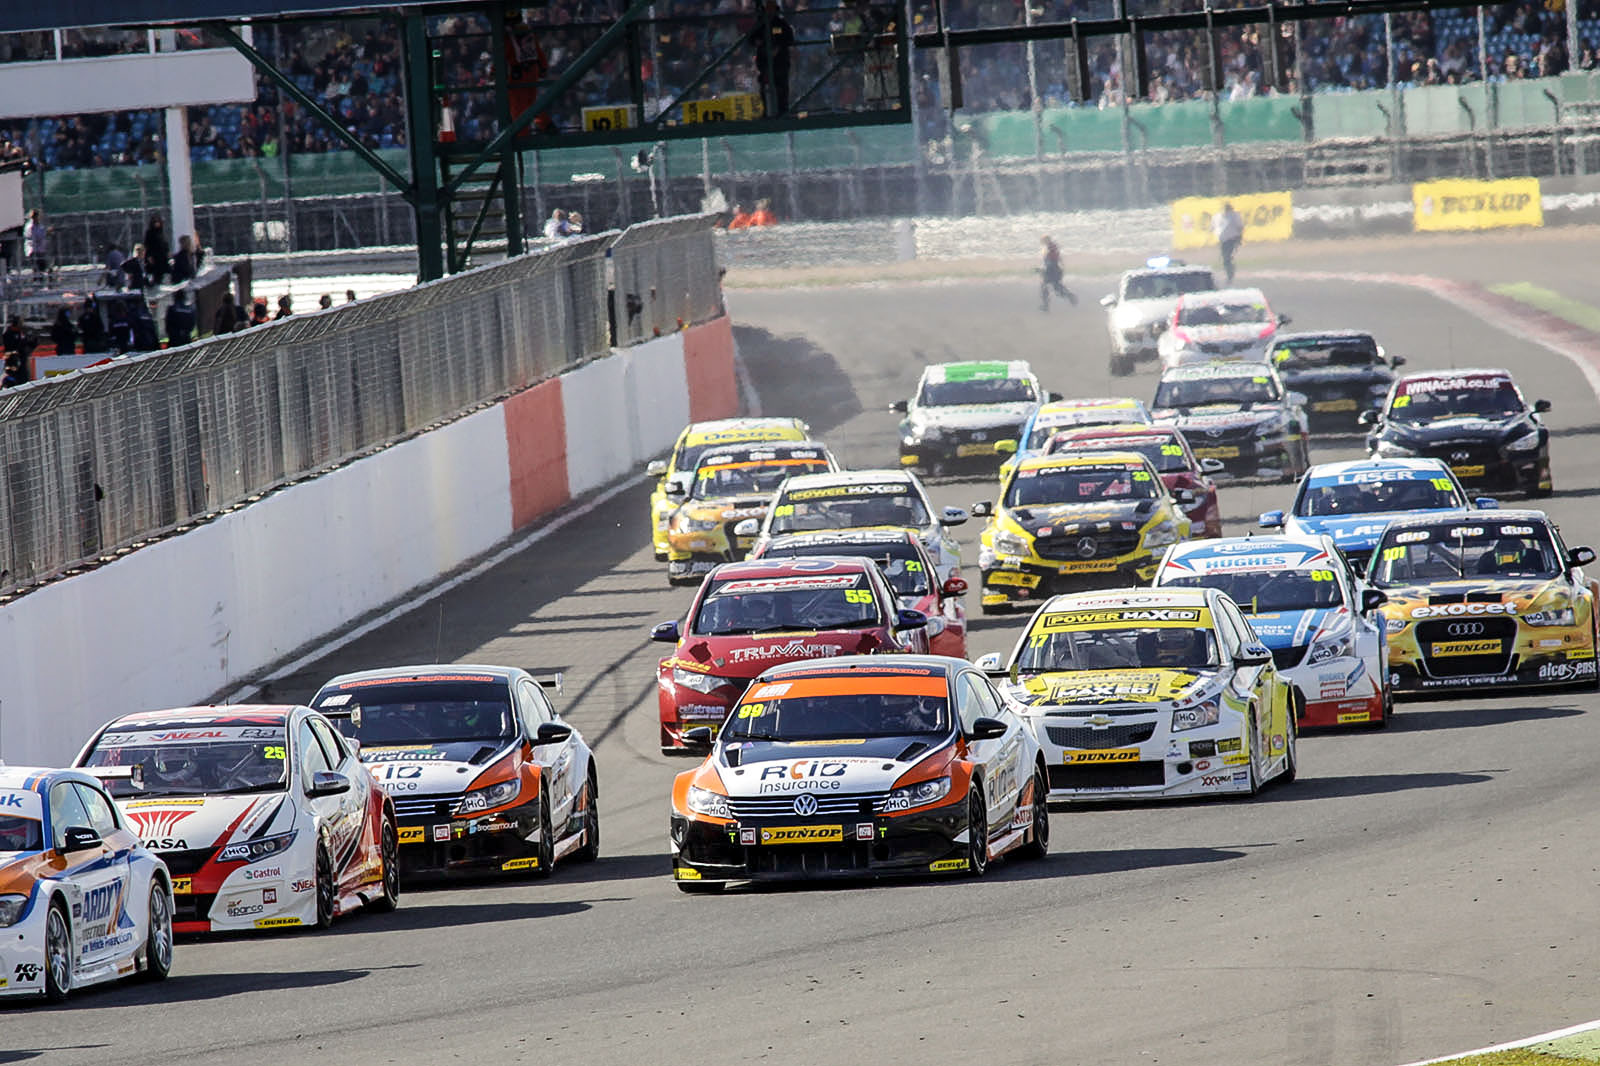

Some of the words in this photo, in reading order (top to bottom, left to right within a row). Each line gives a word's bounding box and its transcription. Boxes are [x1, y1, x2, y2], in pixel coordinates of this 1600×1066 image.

[1338, 470, 1416, 485] LASER
[1429, 478, 1453, 491] 16
[1335, 524, 1385, 539] LAS
[1500, 525, 1534, 536] duo
[1395, 531, 1431, 544] duo
[1383, 546, 1407, 561] 101
[904, 560, 923, 573] 21
[1205, 556, 1287, 569] HUGHES
[844, 589, 873, 604] 55
[1411, 601, 1518, 618] exocet
[1052, 613, 1121, 625] POWER
[1029, 634, 1049, 649] 17
[1444, 643, 1501, 654] DUNLOP
[737, 703, 765, 719] 99
[1179, 713, 1196, 721] HiQ
[263, 746, 286, 760] 25
[368, 751, 448, 762] Ireland
[1075, 752, 1139, 762] DUNLOP
[466, 797, 486, 809] HiQ
[888, 798, 910, 809] HiQ
[708, 804, 728, 816] HiQ
[774, 829, 842, 840] DUNLOP
[145, 838, 189, 850] ASA
[227, 846, 249, 857] HiQ
[252, 866, 281, 879] Castrol
[226, 903, 264, 917] sparco
[264, 917, 301, 926] DUNLOP
